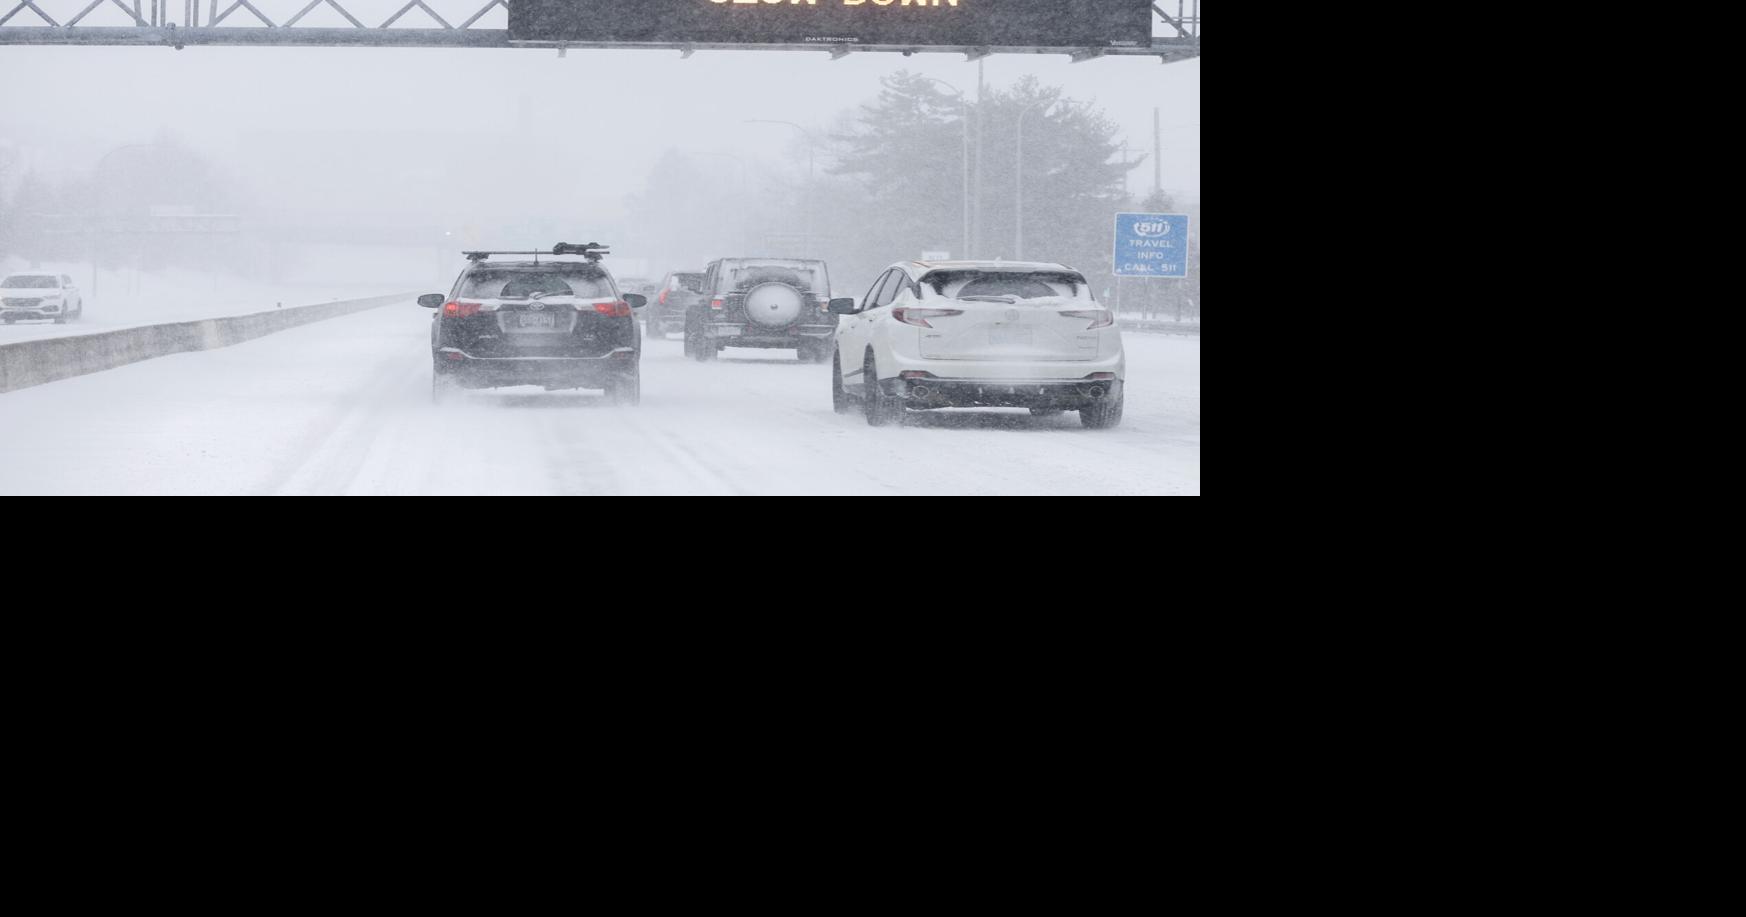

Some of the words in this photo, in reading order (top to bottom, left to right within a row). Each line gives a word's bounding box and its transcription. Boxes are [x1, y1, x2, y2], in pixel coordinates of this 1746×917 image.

[1139, 222, 1163, 233] 511
[1129, 239, 1174, 249] TRAVEL
[1137, 251, 1164, 260] INFO
[1124, 263, 1154, 272] CALL
[1161, 263, 1177, 272] 511
